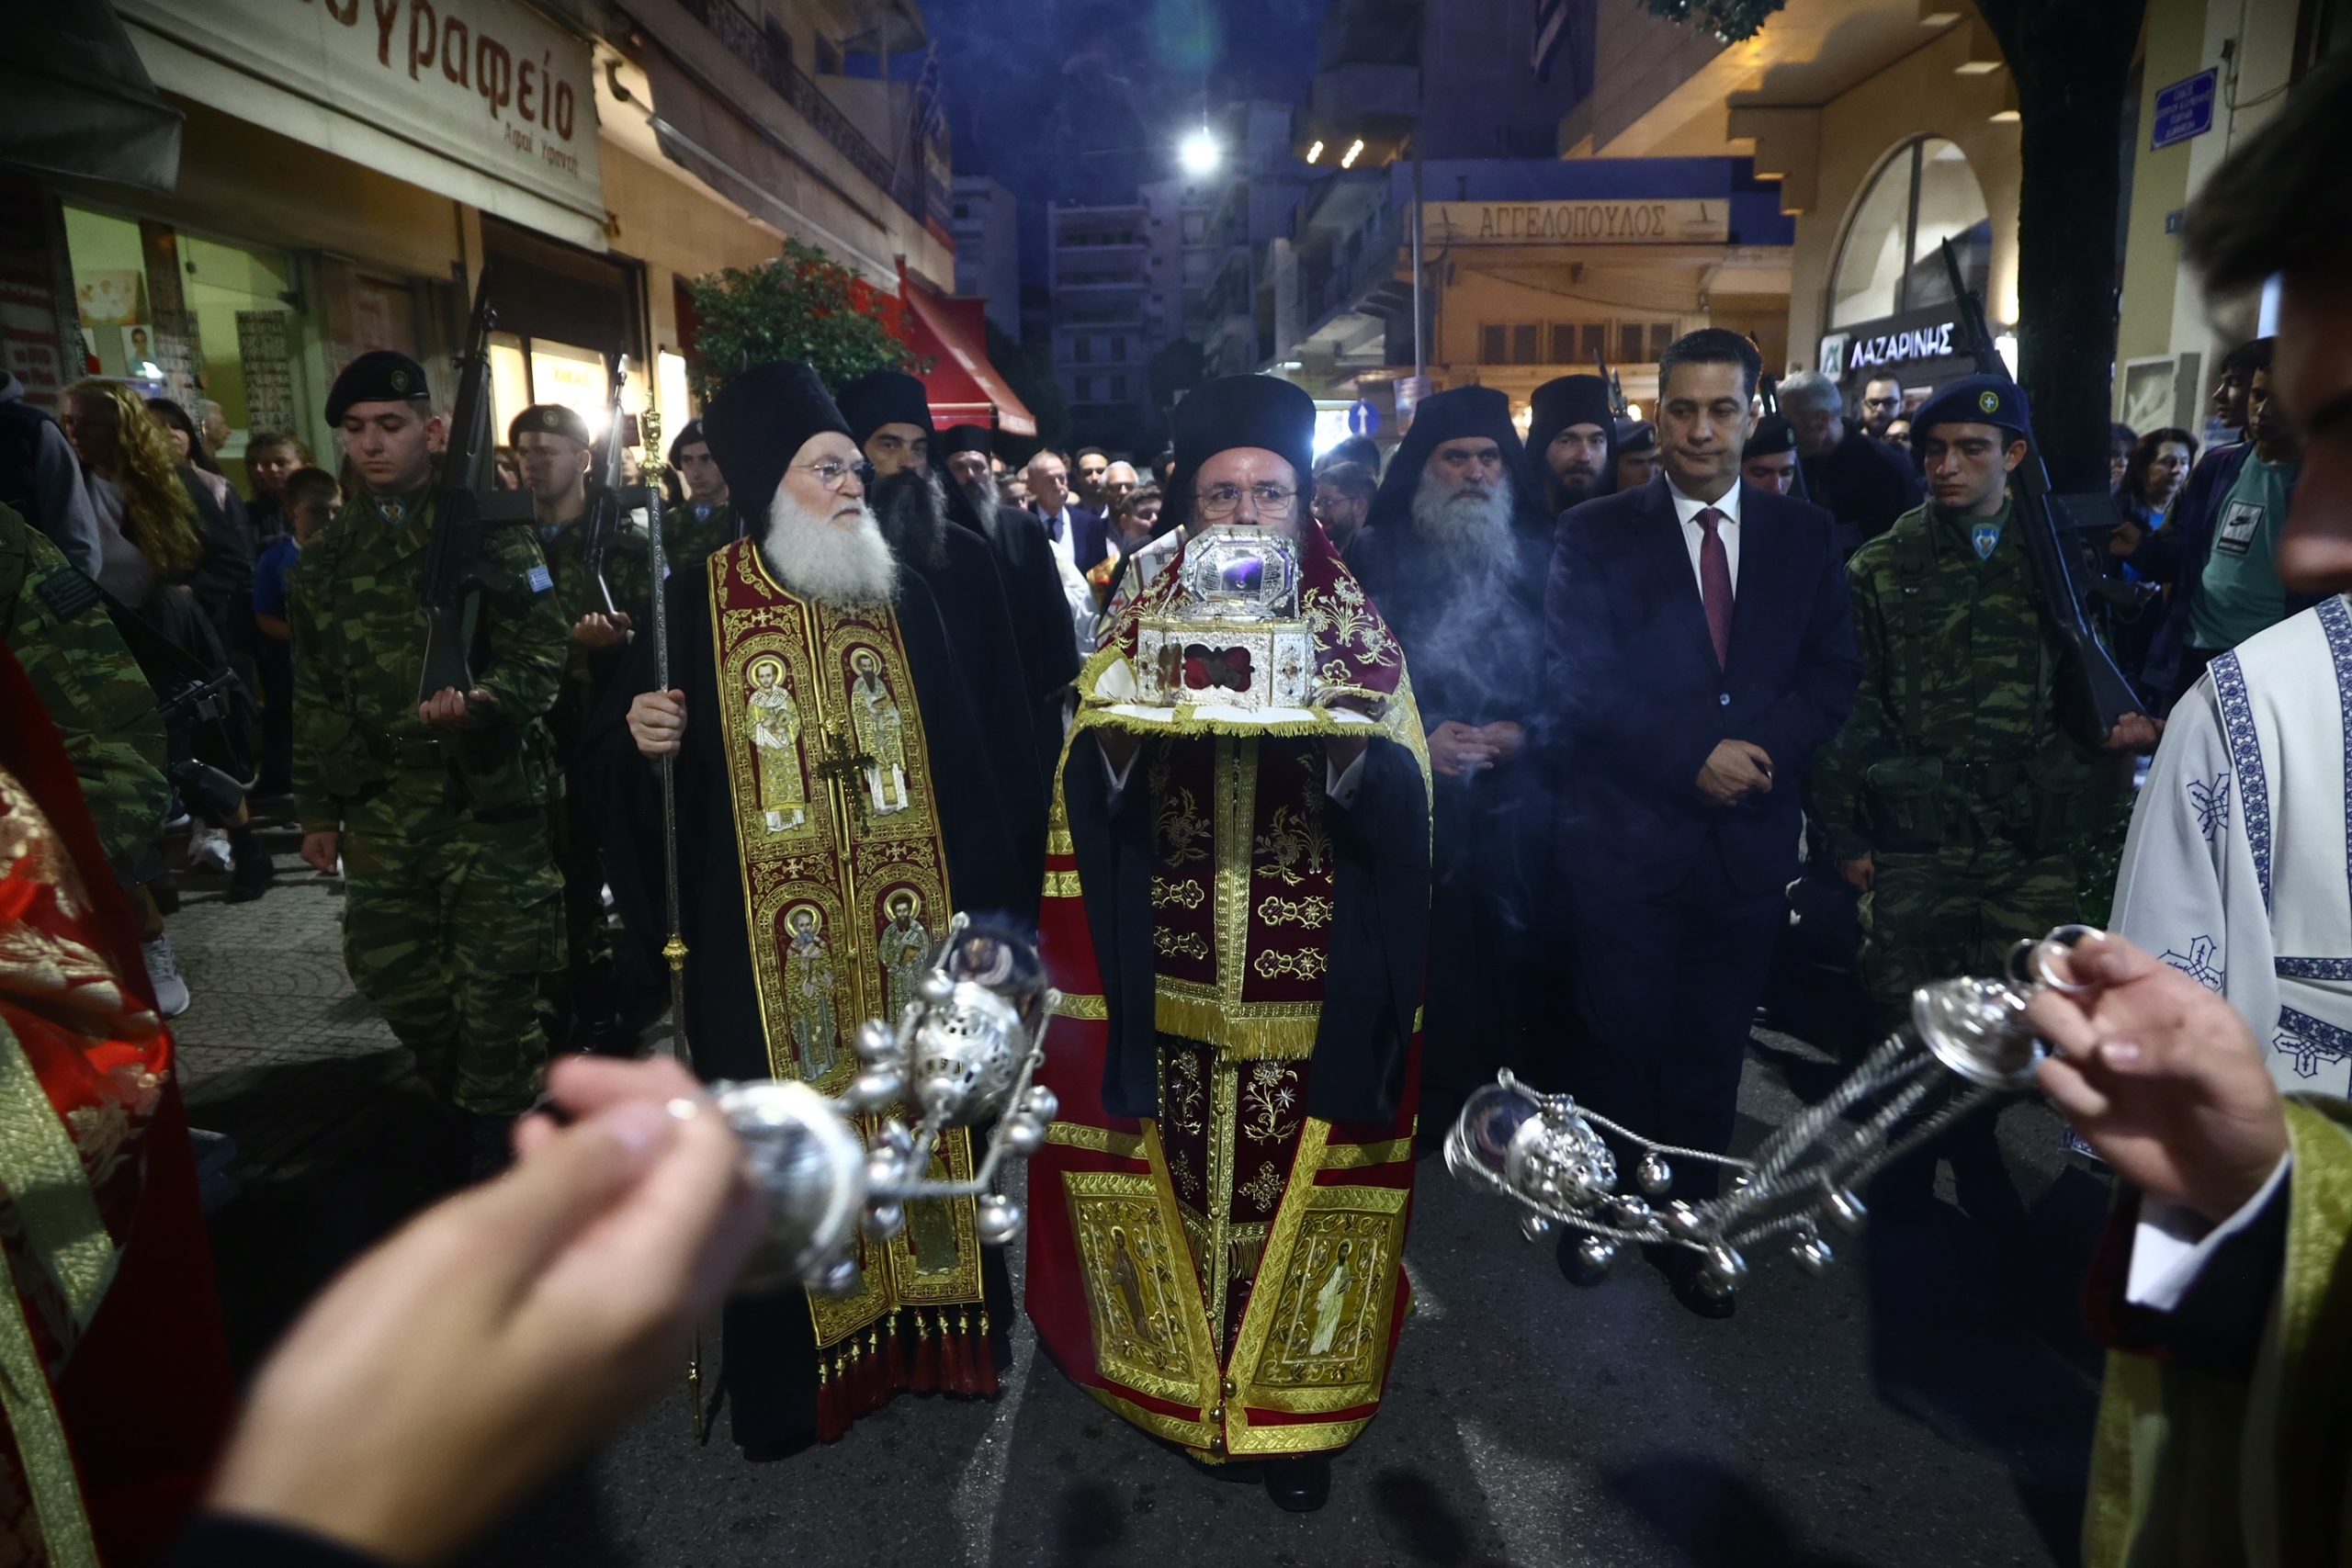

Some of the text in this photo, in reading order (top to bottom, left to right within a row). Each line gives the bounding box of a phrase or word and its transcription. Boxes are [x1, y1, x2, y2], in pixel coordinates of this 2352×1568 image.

[303, 0, 574, 141] γραφείο
[1478, 205, 1667, 239] ΑΓΓΕΛΟΠΟΥΛΟΣ
[1849, 321, 1955, 370] ΛΑΖΑΡΙΝΗΣ
